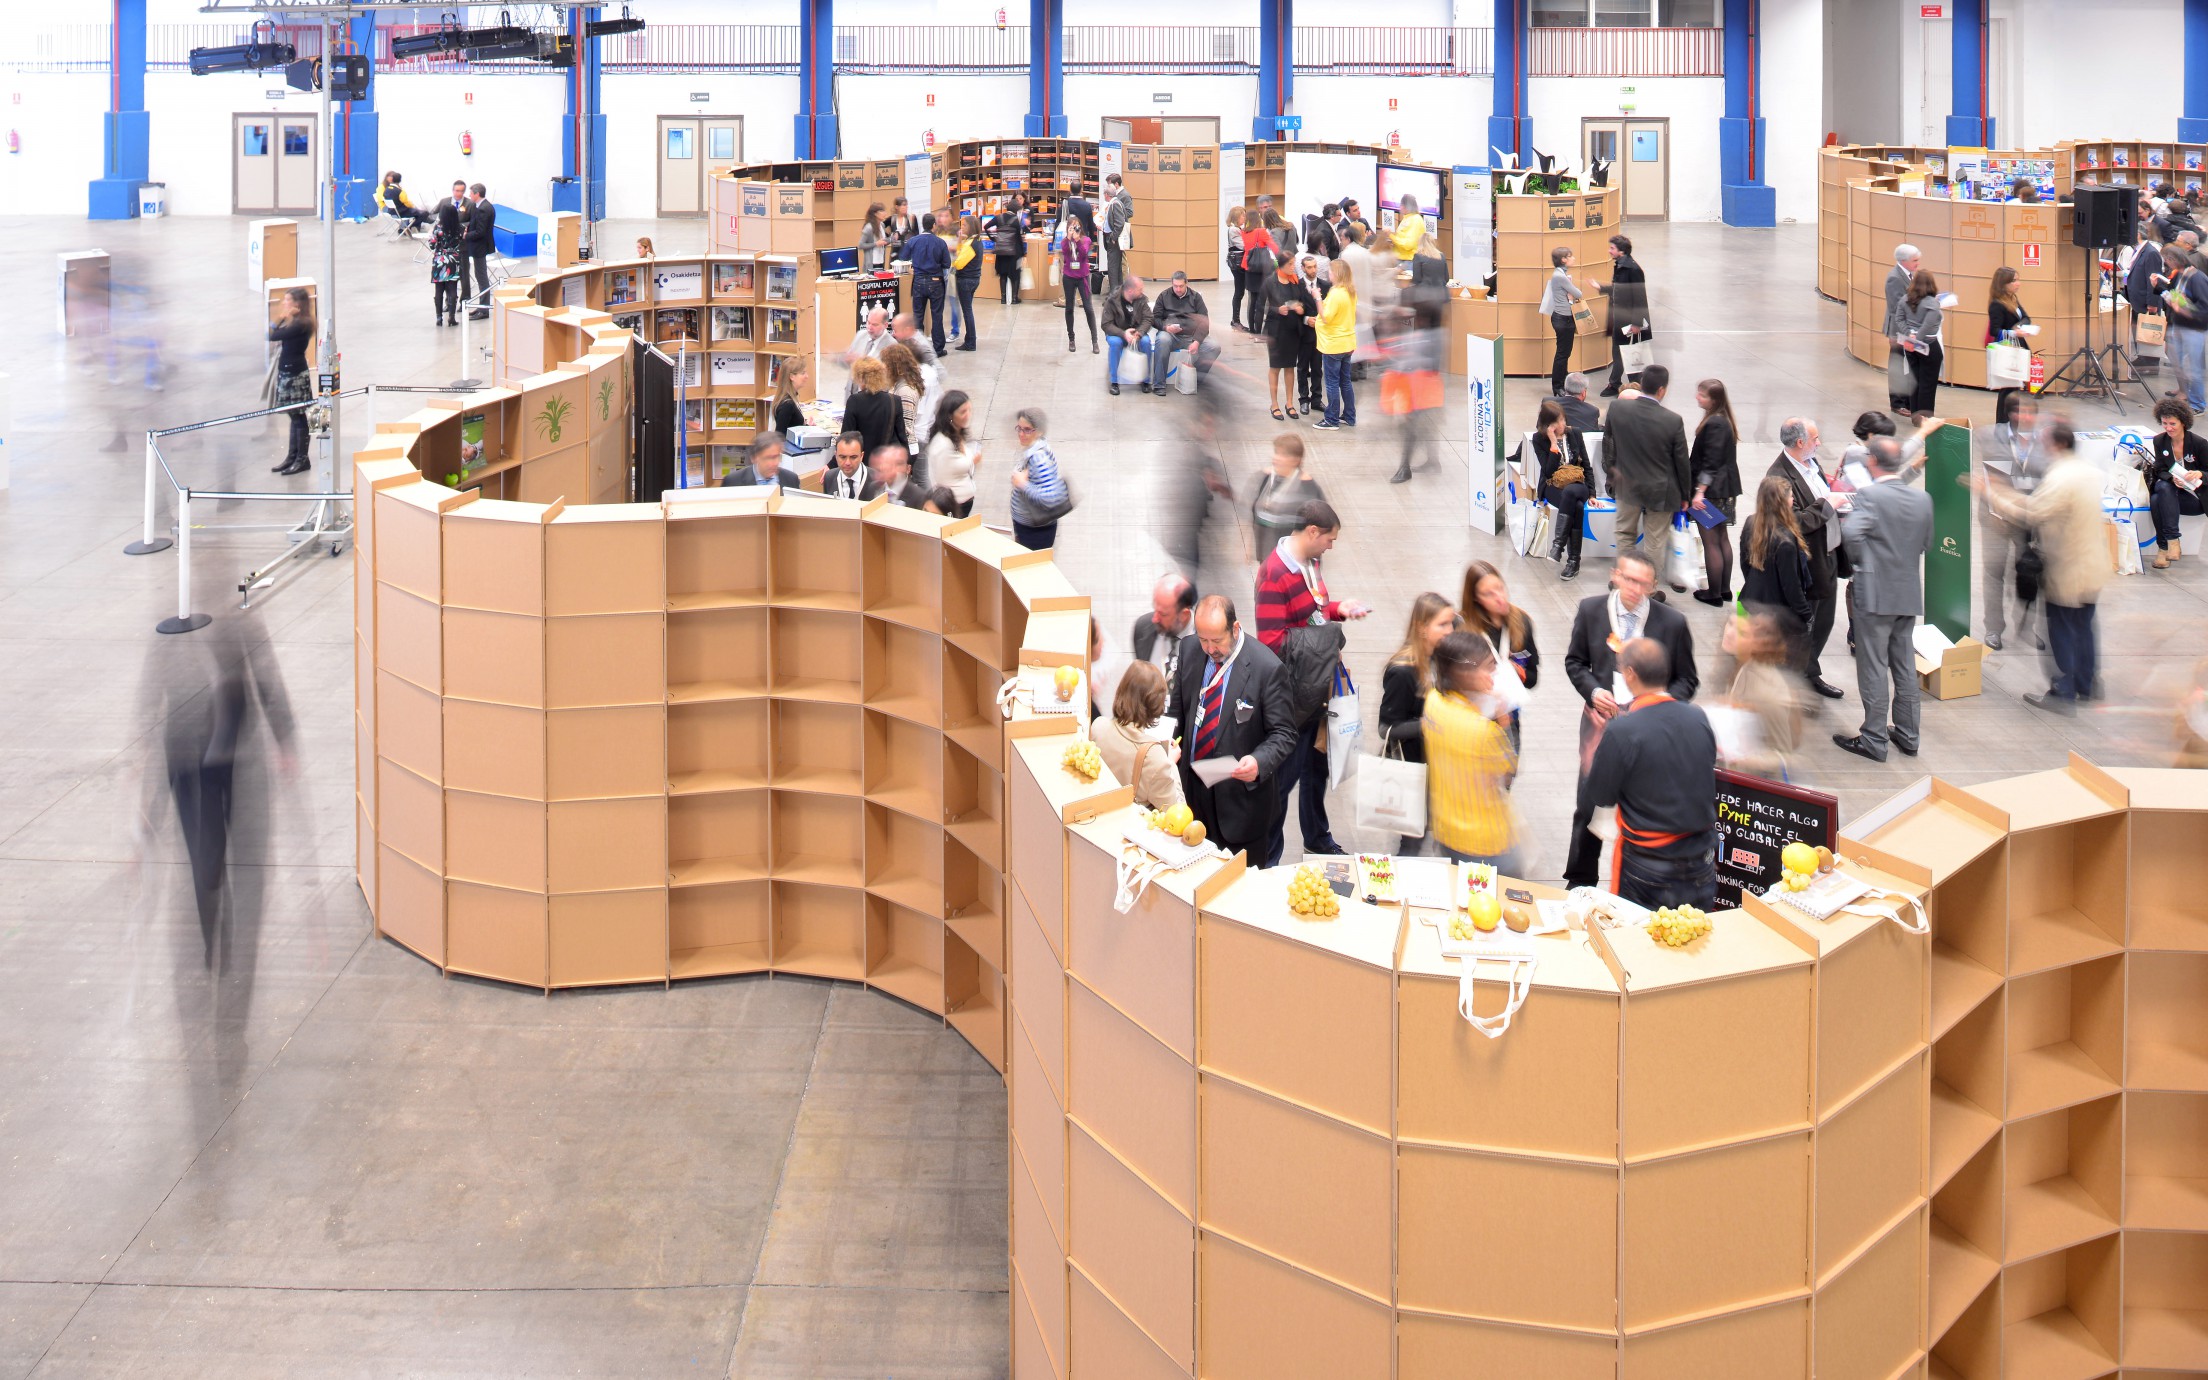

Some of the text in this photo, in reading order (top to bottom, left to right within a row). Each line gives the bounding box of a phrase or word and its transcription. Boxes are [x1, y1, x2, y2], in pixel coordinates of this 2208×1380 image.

[670, 271, 701, 279] Osakidetza
[857, 279, 899, 290] HOSPITAL PLATÓ
[1478, 440, 1484, 453] LA
[1715, 793, 1818, 827] UEDE HACER ALGO
[1719, 803, 1803, 842] PYME ANTE EL
[1735, 828, 1779, 848] GLOBAL
